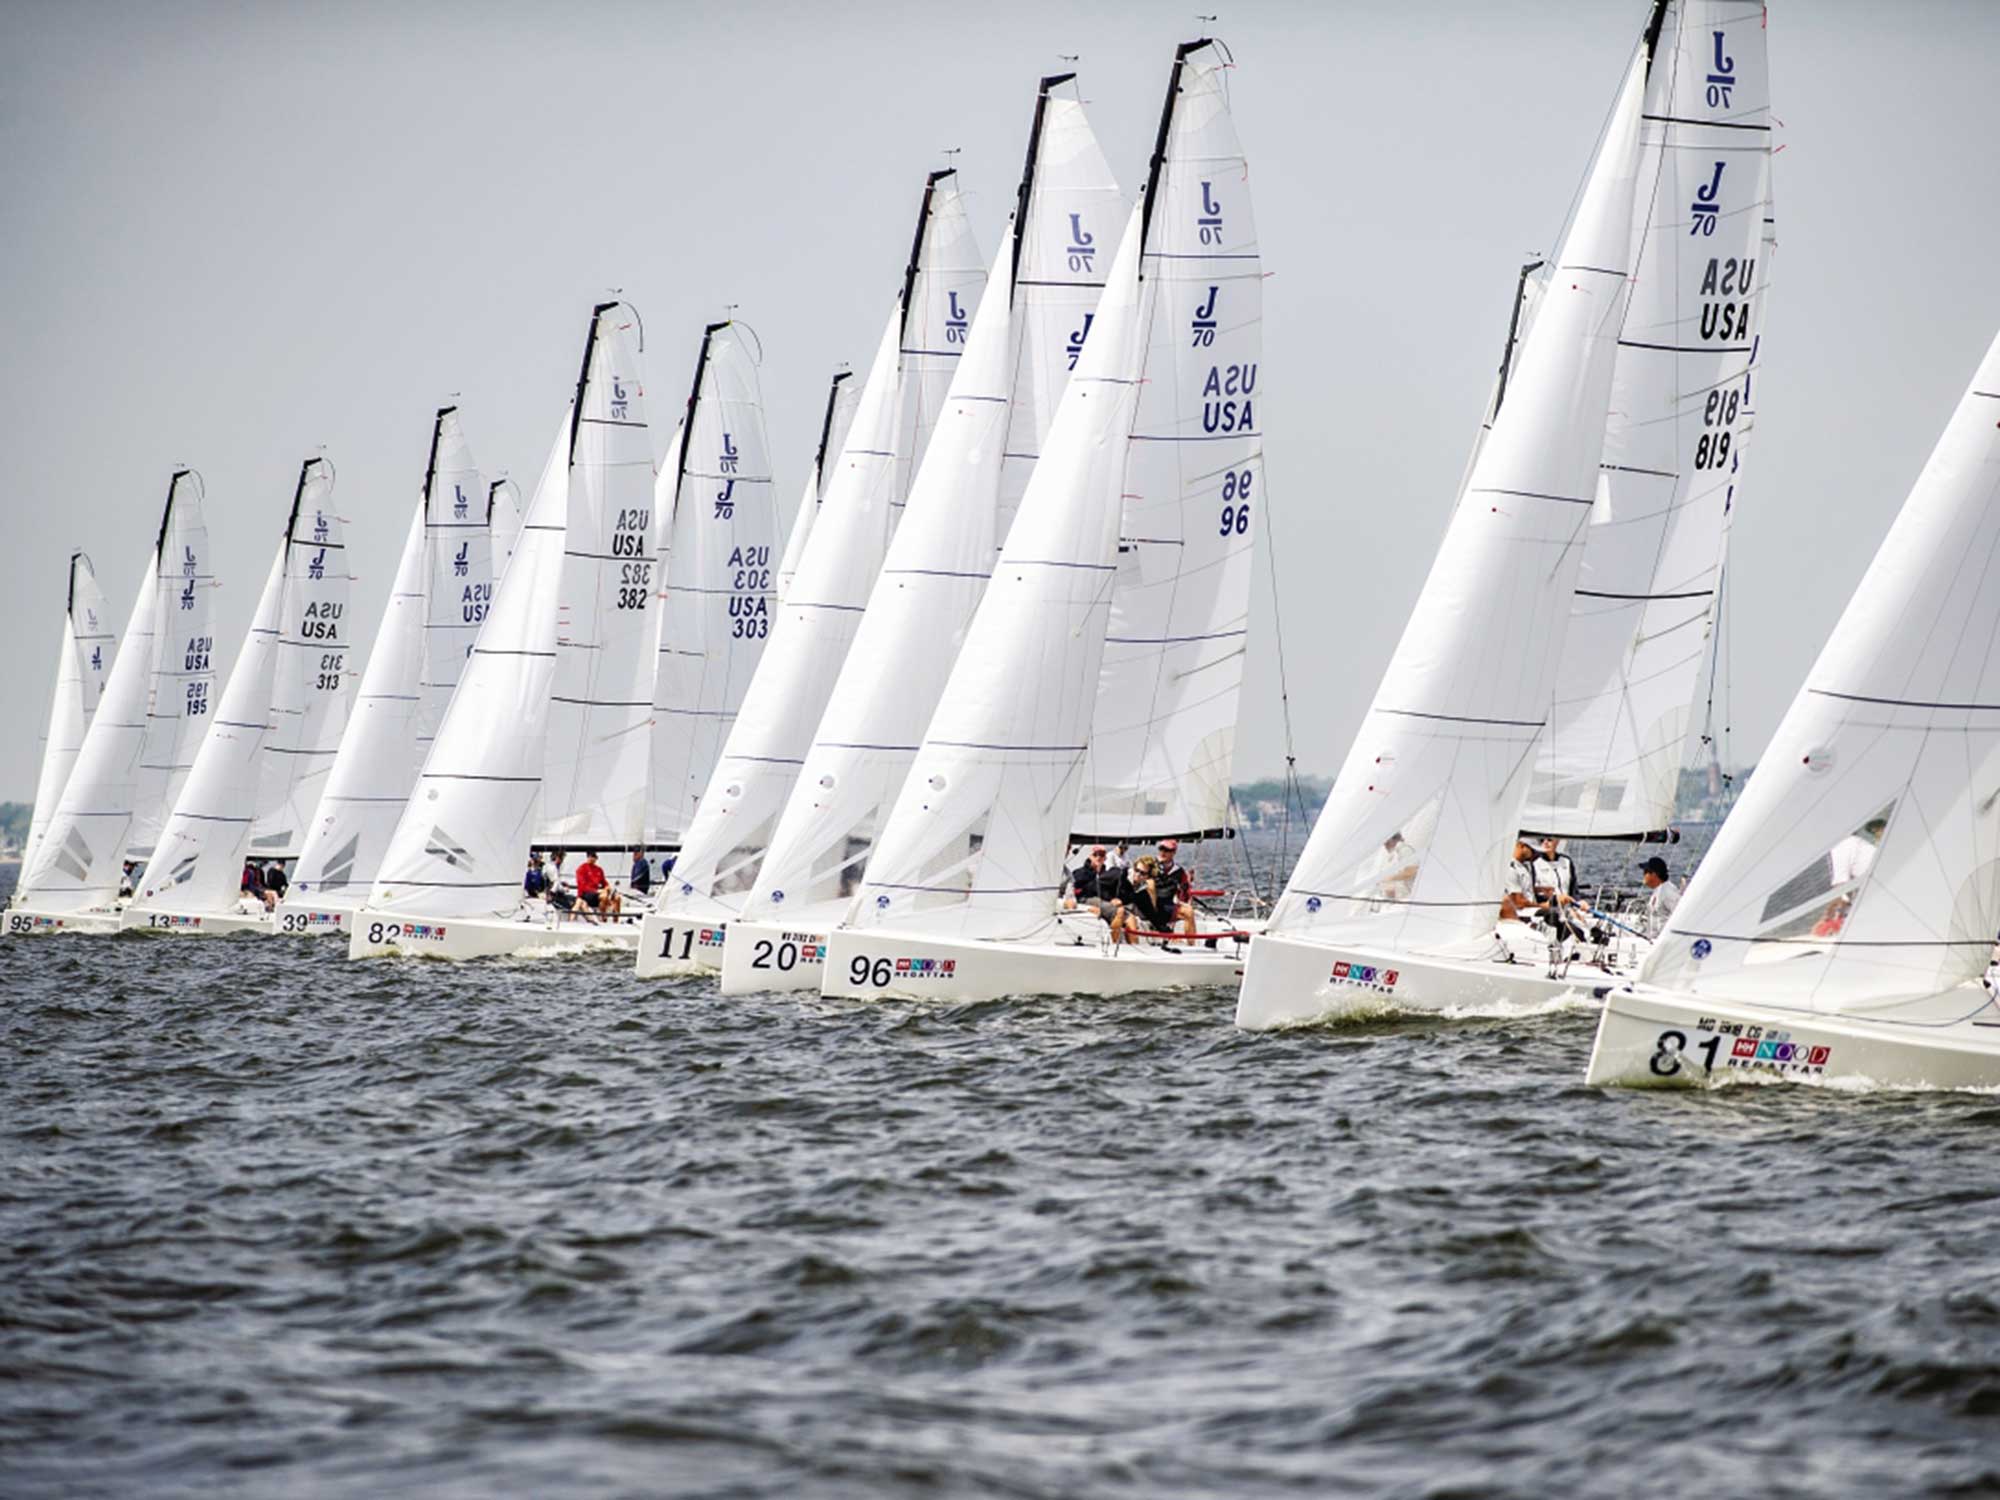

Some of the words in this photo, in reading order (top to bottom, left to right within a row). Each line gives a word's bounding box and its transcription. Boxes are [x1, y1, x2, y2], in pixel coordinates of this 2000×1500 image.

[1697, 161, 1726, 202] J
[1690, 213, 1716, 237] 70
[1195, 286, 1219, 320] J
[1070, 313, 1095, 344] J
[1700, 302, 1750, 341] USA
[1192, 329, 1215, 348] 70
[1067, 354, 1080, 371] 7
[1203, 400, 1254, 433] USA
[1694, 431, 1731, 470] 819
[717, 479, 735, 501] J
[714, 506, 733, 520] 70
[1219, 504, 1250, 537] 96
[612, 533, 644, 556] USA
[617, 587, 648, 610] 382
[728, 596, 767, 617] USA
[301, 621, 337, 639] USA
[732, 618, 768, 639] 303
[185, 654, 209, 670] USA
[316, 673, 340, 690] 313
[187, 699, 208, 716] 195
[10, 915, 33, 932] 95
[149, 914, 170, 928] 13
[282, 914, 308, 932] 39
[368, 922, 400, 945] 82
[658, 927, 695, 959] 11
[752, 940, 797, 971] 20
[849, 955, 893, 987] 96
[1650, 1030, 1721, 1078] 81
[1756, 1040, 1831, 1065] NOOD
